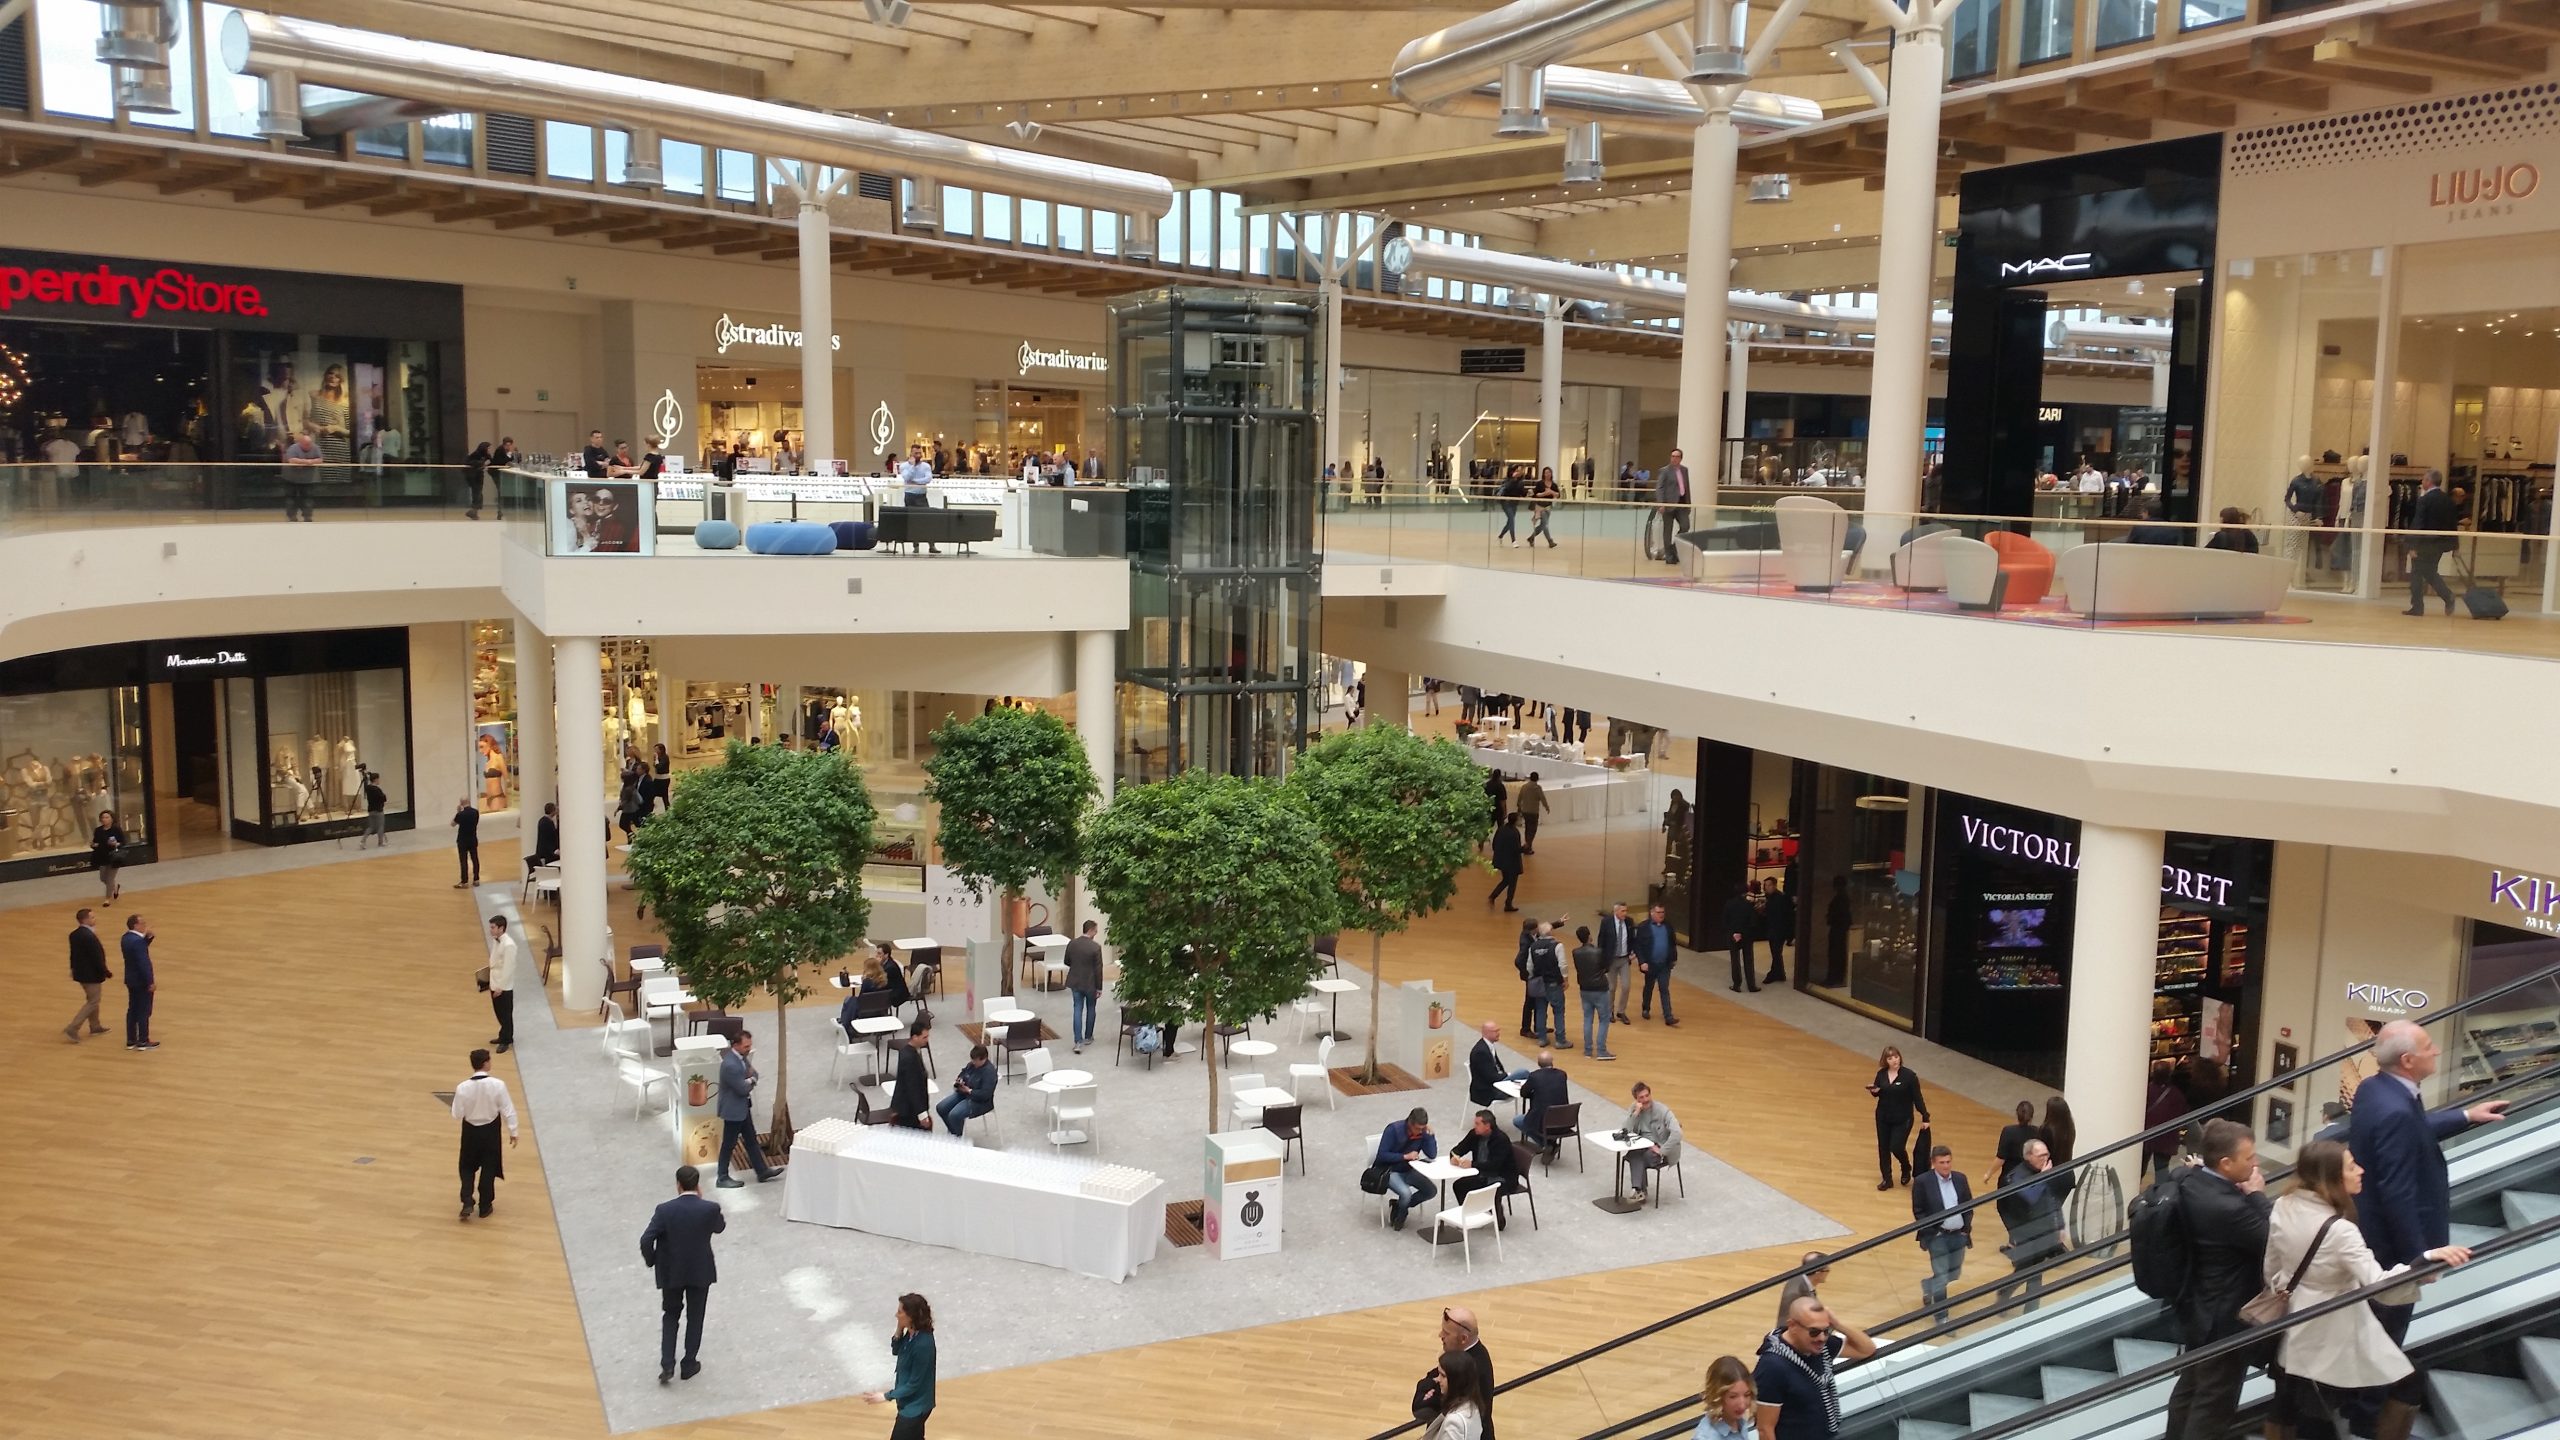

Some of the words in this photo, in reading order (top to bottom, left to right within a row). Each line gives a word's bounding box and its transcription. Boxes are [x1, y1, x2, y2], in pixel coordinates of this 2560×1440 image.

[2447, 204, 2514, 224] JEANS
[730, 322, 841, 350] stradivas
[166, 654, 216, 667] Massimo
[217, 651, 248, 664] Dutti
[2025, 892, 2054, 900] SECRET
[2347, 982, 2430, 1009] KIKO
